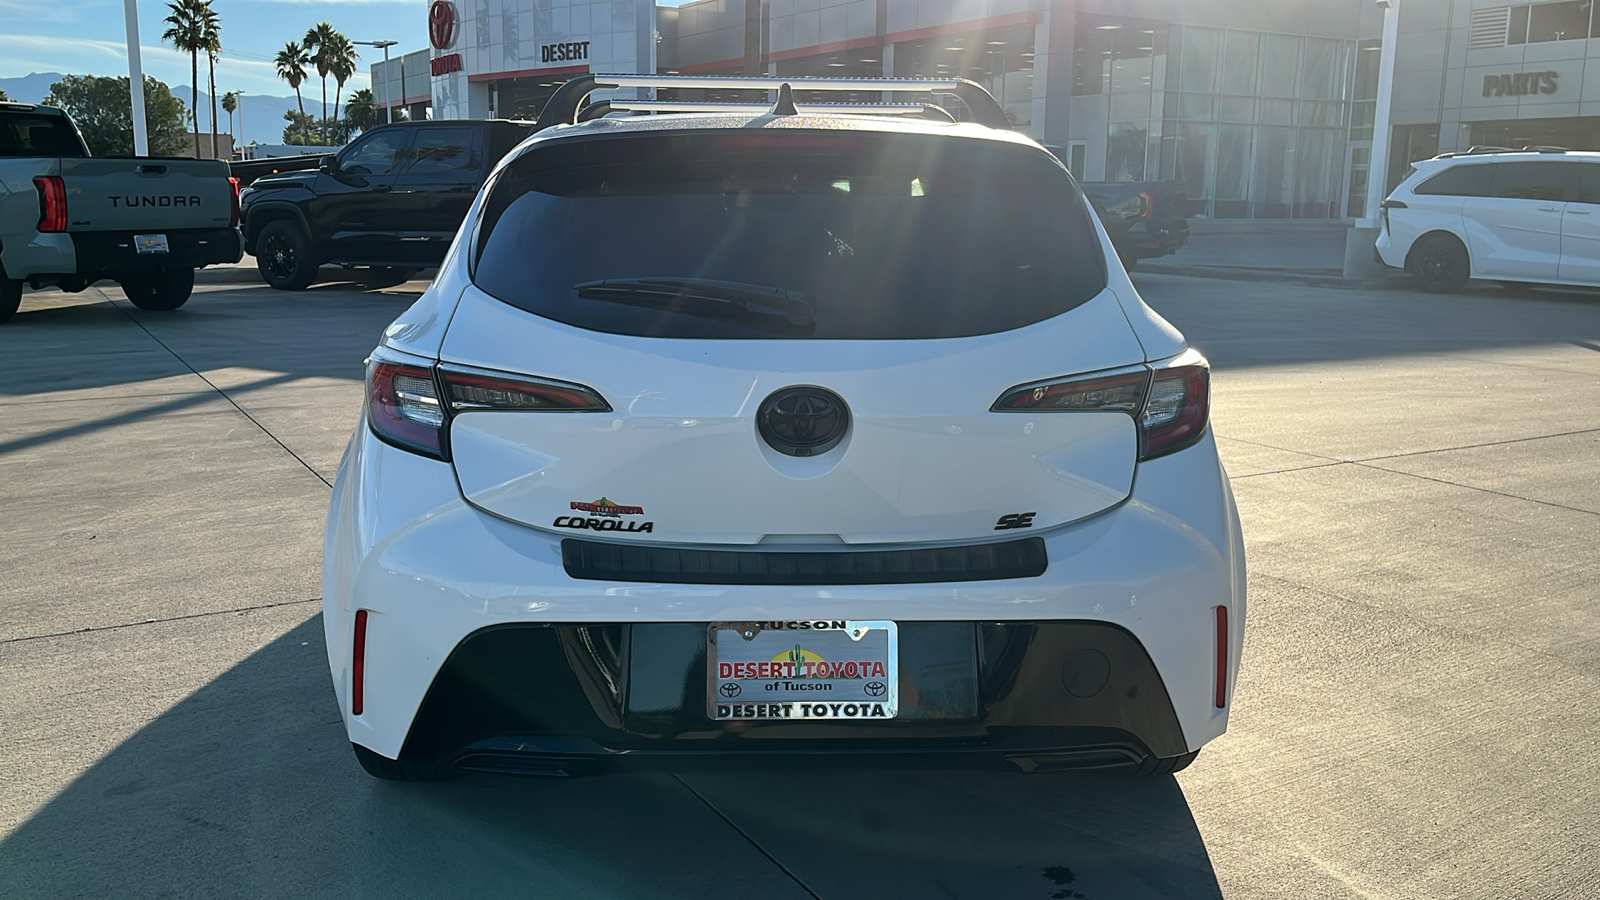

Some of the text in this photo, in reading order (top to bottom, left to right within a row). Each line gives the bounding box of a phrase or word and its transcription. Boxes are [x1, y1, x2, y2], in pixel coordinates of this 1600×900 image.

[541, 41, 590, 63] DESERT
[430, 53, 463, 77] TOYOTA
[1482, 71, 1559, 97] PARTS
[108, 195, 201, 208] TUNDRA
[553, 516, 653, 533] COROLLA
[994, 511, 1037, 530] SE
[759, 620, 847, 630] TUCSON
[719, 661, 886, 679] DESERT TOYOTA
[764, 681, 832, 691] of Tucson
[717, 703, 887, 718] DESERT TOYOTA
